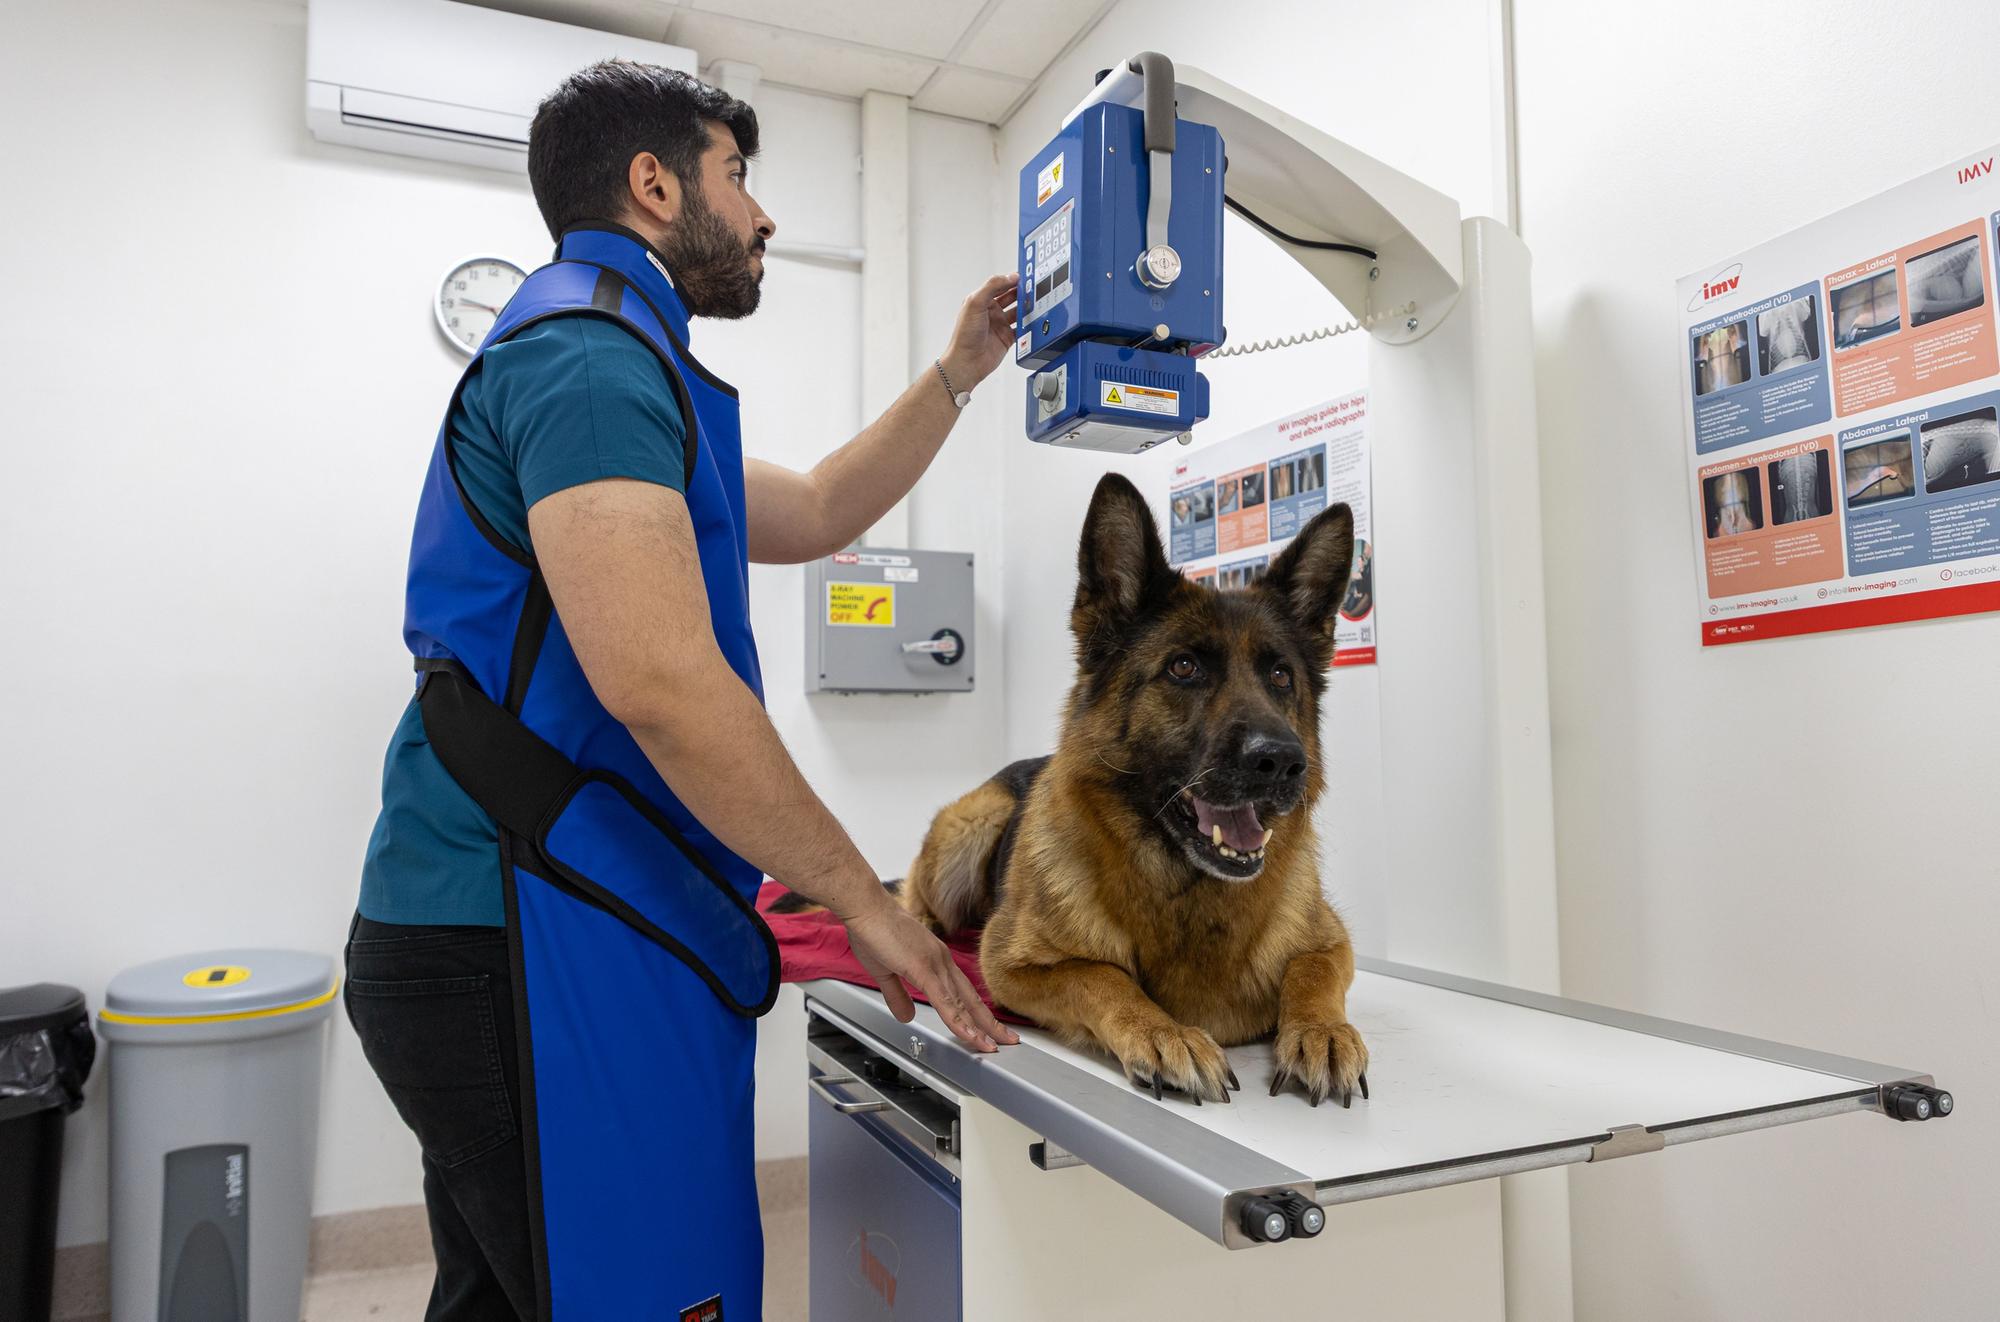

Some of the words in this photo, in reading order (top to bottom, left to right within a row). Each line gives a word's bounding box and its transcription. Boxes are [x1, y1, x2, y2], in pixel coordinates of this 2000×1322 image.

[1958, 157, 1993, 184] IMV
[1827, 270, 1856, 286] Thorax
[1866, 253, 1896, 271] Lateral
[1703, 275, 1740, 300] imv
[1692, 323, 1716, 335] Thorax
[1723, 300, 1771, 323] Ventrodorsal
[1773, 292, 1792, 307] (VD)
[1278, 422, 1290, 432] IMV
[1292, 413, 1318, 428] imaging
[1319, 405, 1338, 420] guide
[1339, 402, 1349, 411] for
[1350, 396, 1365, 406] hips
[1289, 431, 1302, 441] and
[1303, 424, 1323, 437] elbow
[1324, 409, 1365, 430] radiographs
[1842, 423, 1886, 441] Abdomen
[1896, 412, 1929, 427] Lateral
[1701, 461, 1740, 475] Abdomen
[1747, 447, 1798, 464] Ventrodorsal
[1800, 441, 1819, 453] (VD)
[831, 612, 852, 622] OFF
